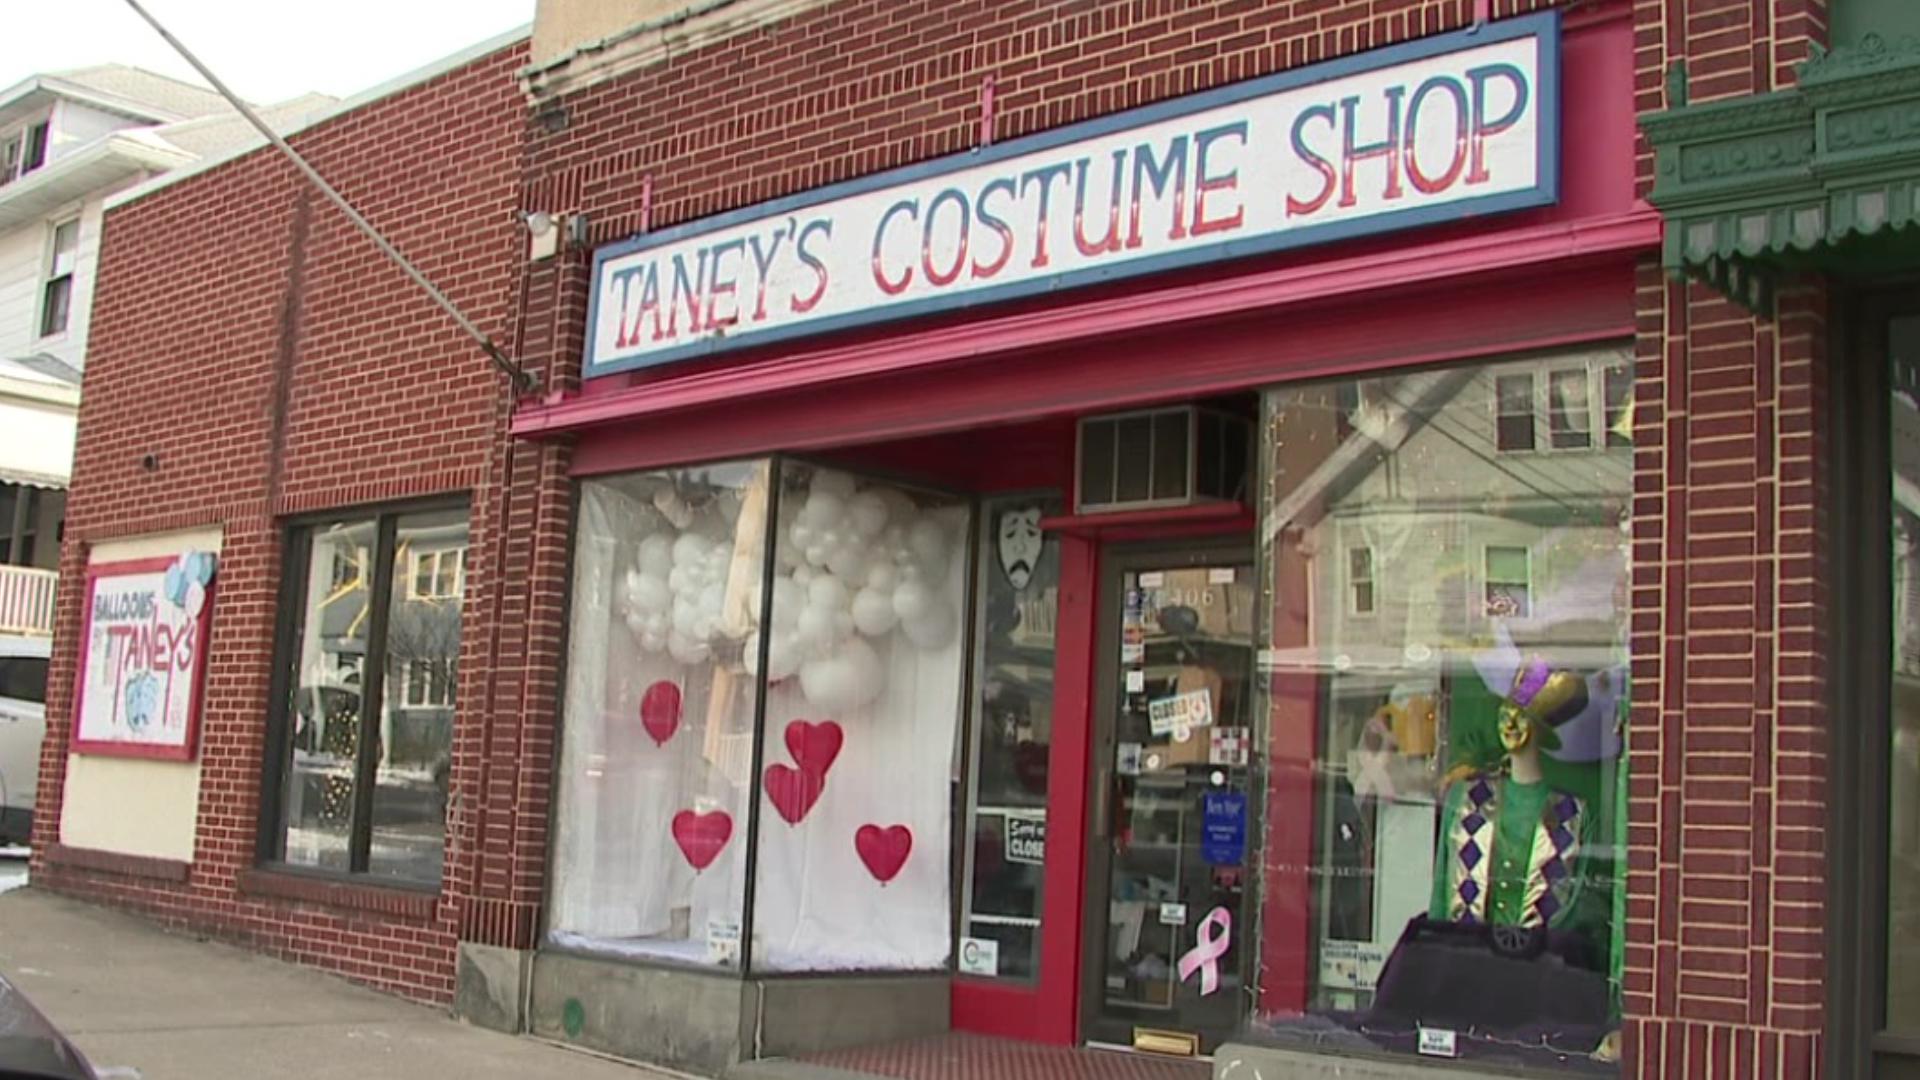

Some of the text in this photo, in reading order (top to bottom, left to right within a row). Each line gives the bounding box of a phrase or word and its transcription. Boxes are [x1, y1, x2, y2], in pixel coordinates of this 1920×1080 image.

[612, 62, 1529, 348] TANEY'S COSTUME SHOP
[95, 591, 155, 621] BALLOONS
[106, 604, 195, 723] TANEY'S
